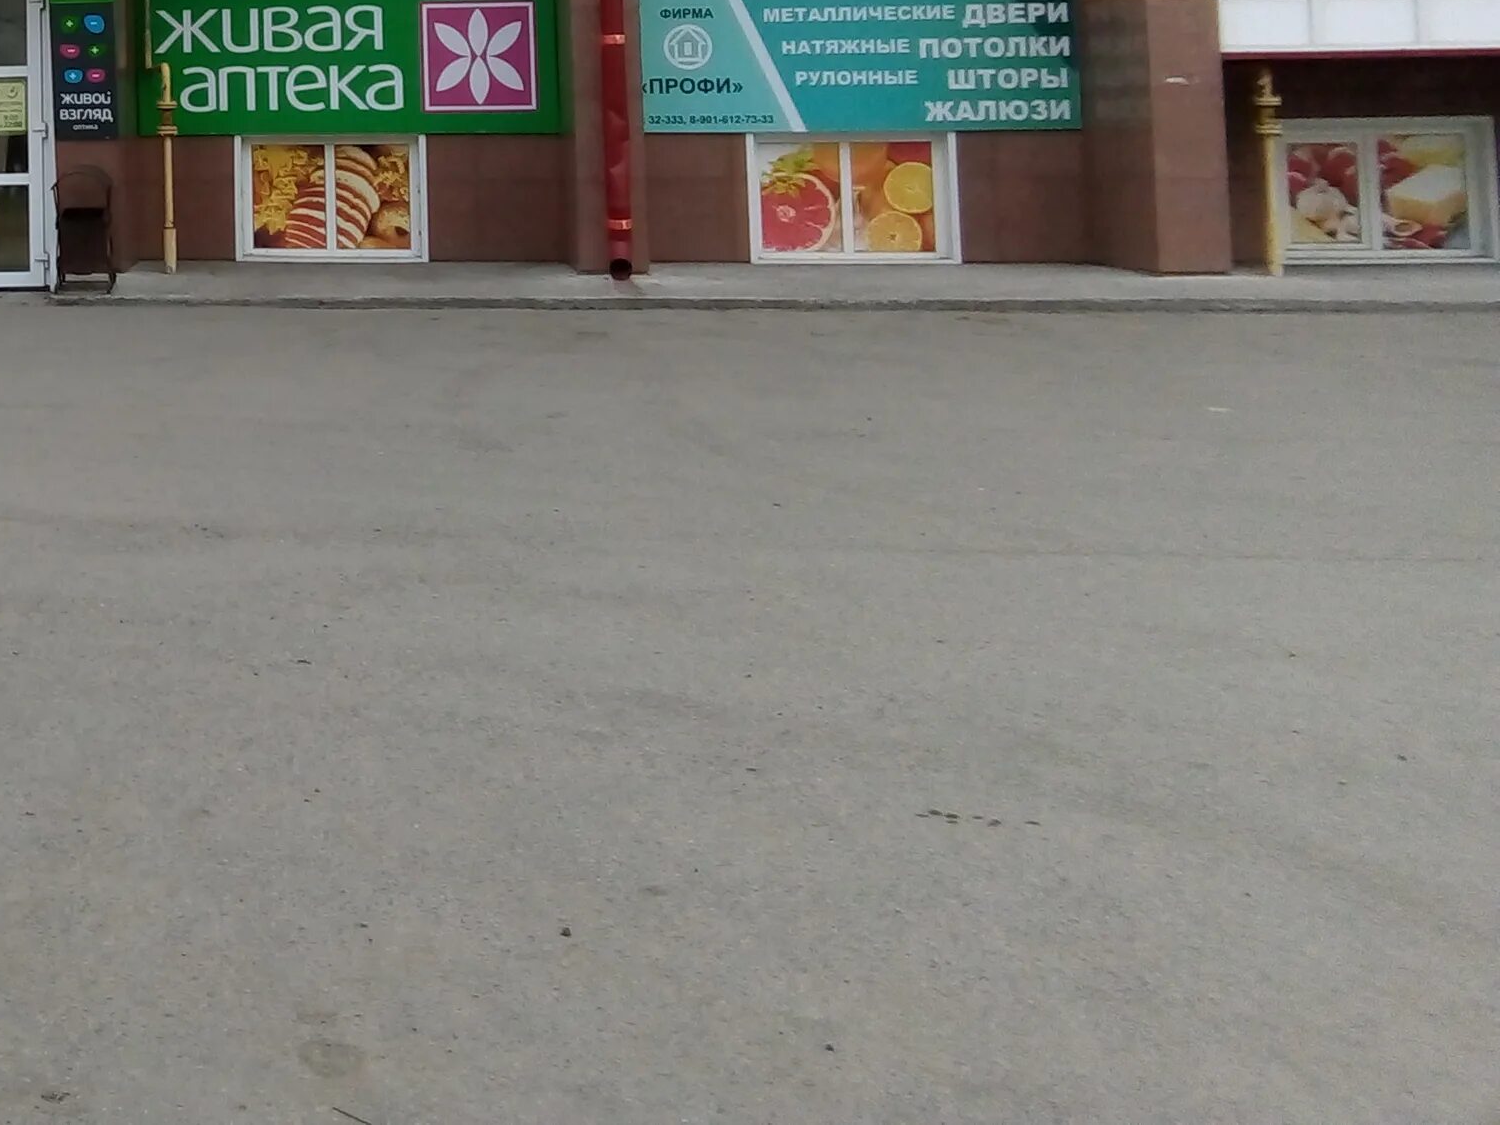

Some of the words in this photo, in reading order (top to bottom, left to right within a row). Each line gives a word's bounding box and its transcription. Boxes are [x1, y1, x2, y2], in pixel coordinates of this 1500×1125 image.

[659, 7, 714, 19] ФИРМА
[762, 4, 956, 23] МЕТАЛЛИЧЕСКИЕ
[962, 1, 1070, 28] ДВЕРИ
[154, 4, 385, 54] живая
[781, 37, 911, 55] НАТЯЖНЫЕ
[919, 35, 1071, 59] ПОТОЛКИ
[179, 63, 405, 113] аптека
[794, 69, 919, 87] РУЛОННЫЕ
[947, 67, 1069, 90] ШТОРЫ
[924, 99, 1072, 122] ЖАЛЮЗИ
